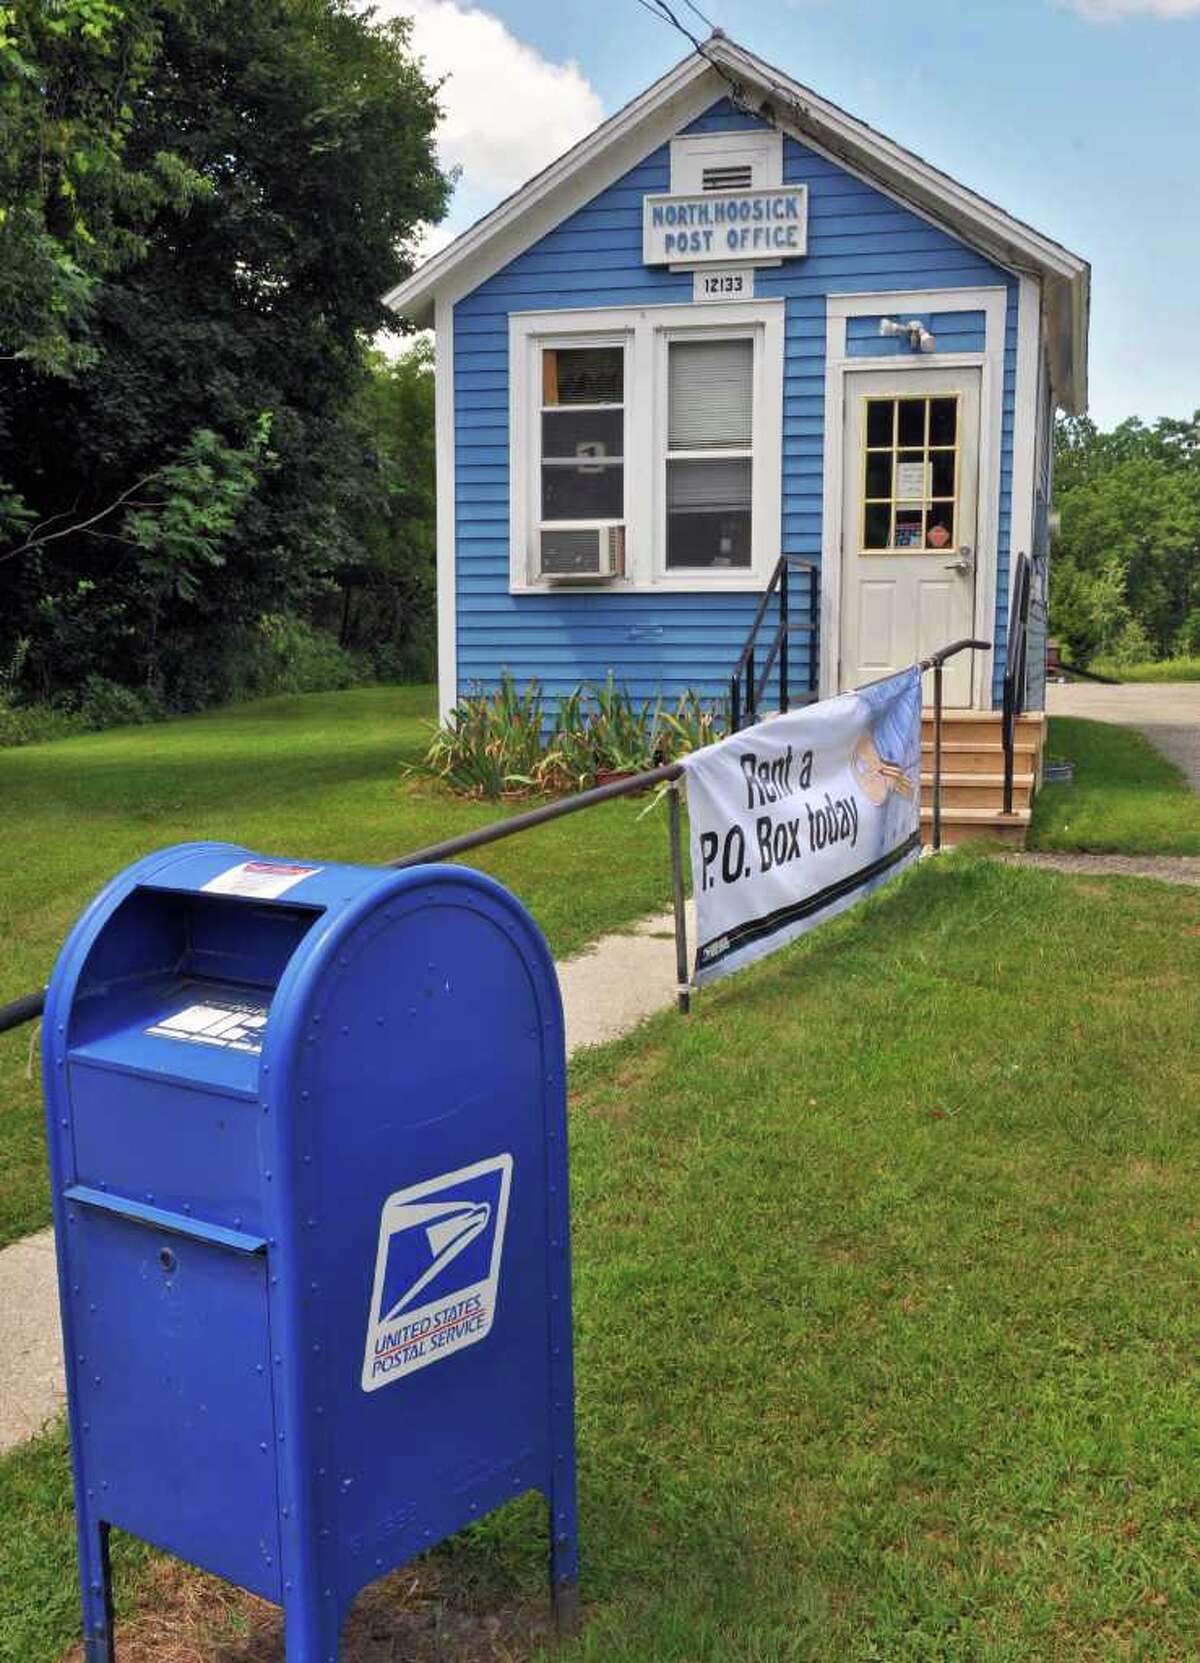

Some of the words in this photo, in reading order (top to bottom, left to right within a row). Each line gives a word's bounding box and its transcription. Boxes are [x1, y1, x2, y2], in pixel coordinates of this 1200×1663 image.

[664, 231, 713, 253] POST
[727, 226, 798, 248] OFFICE
[705, 277, 743, 293] 12133
[740, 745, 793, 810] Rent
[799, 750, 813, 791] a
[700, 823, 750, 891] P.O.
[757, 814, 801, 873] Box
[806, 794, 858, 852] today
[372, 1343, 426, 1378] POSTAL
[430, 1312, 486, 1352] SERVICE
[375, 1317, 431, 1354] UNITED
[434, 1294, 481, 1329] STATES
